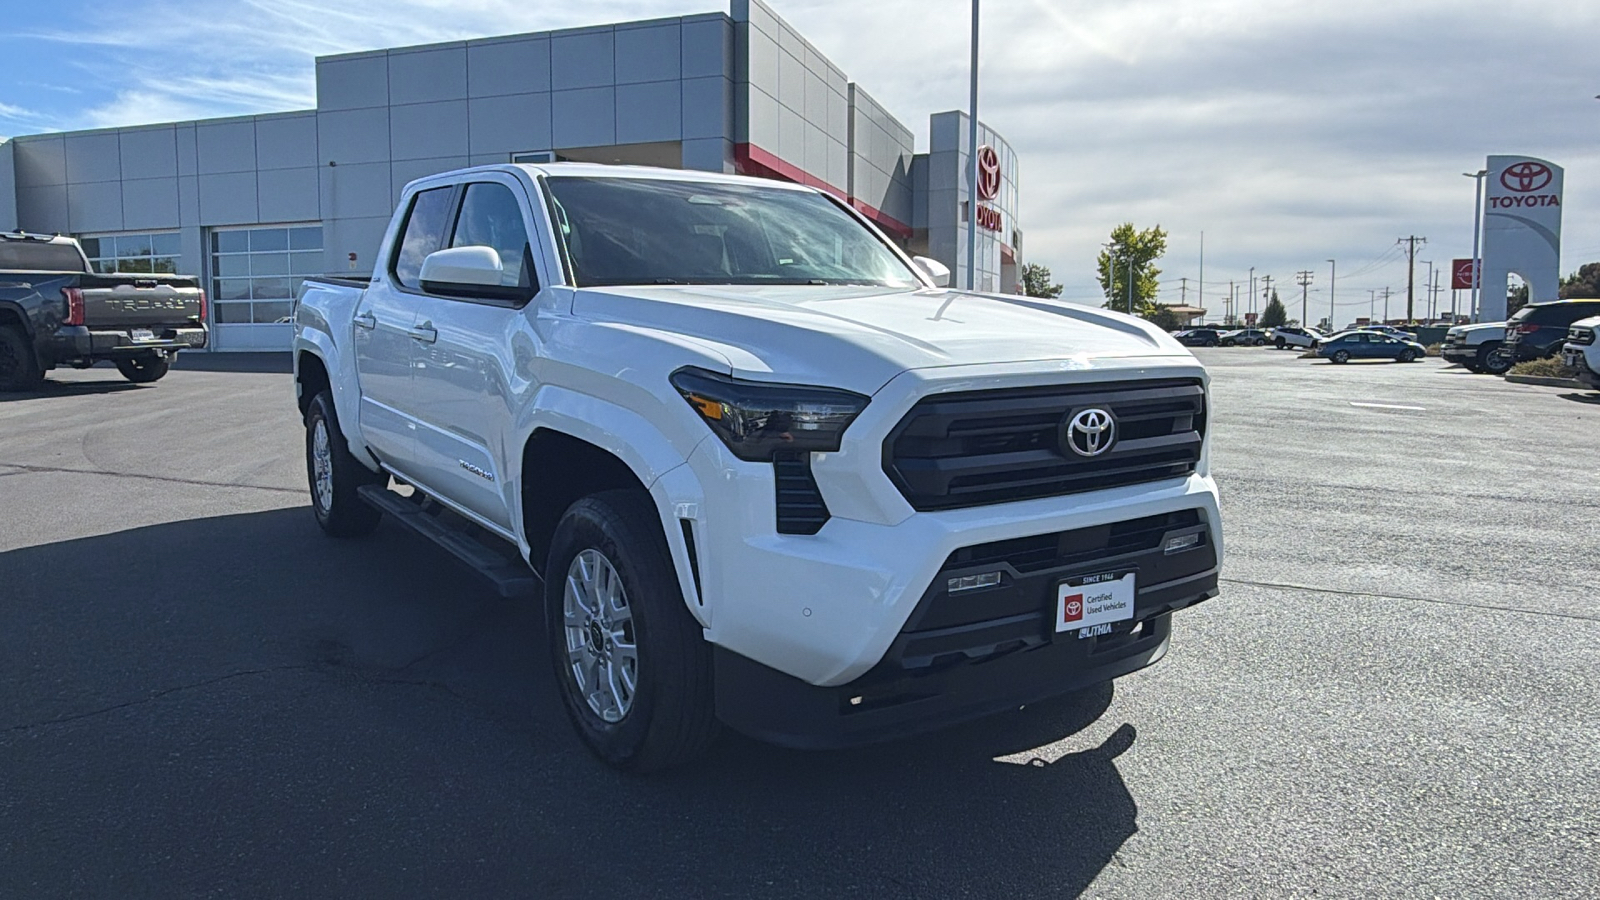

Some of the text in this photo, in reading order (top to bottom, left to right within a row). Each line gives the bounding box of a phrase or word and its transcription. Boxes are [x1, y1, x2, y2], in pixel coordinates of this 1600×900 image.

[1489, 194, 1560, 209] TOYOTA
[976, 203, 1003, 233] OYOTA
[1082, 574, 1100, 584] SINCE
[1086, 592, 1113, 605] Certified
[1086, 600, 1127, 615] Used Vehicles
